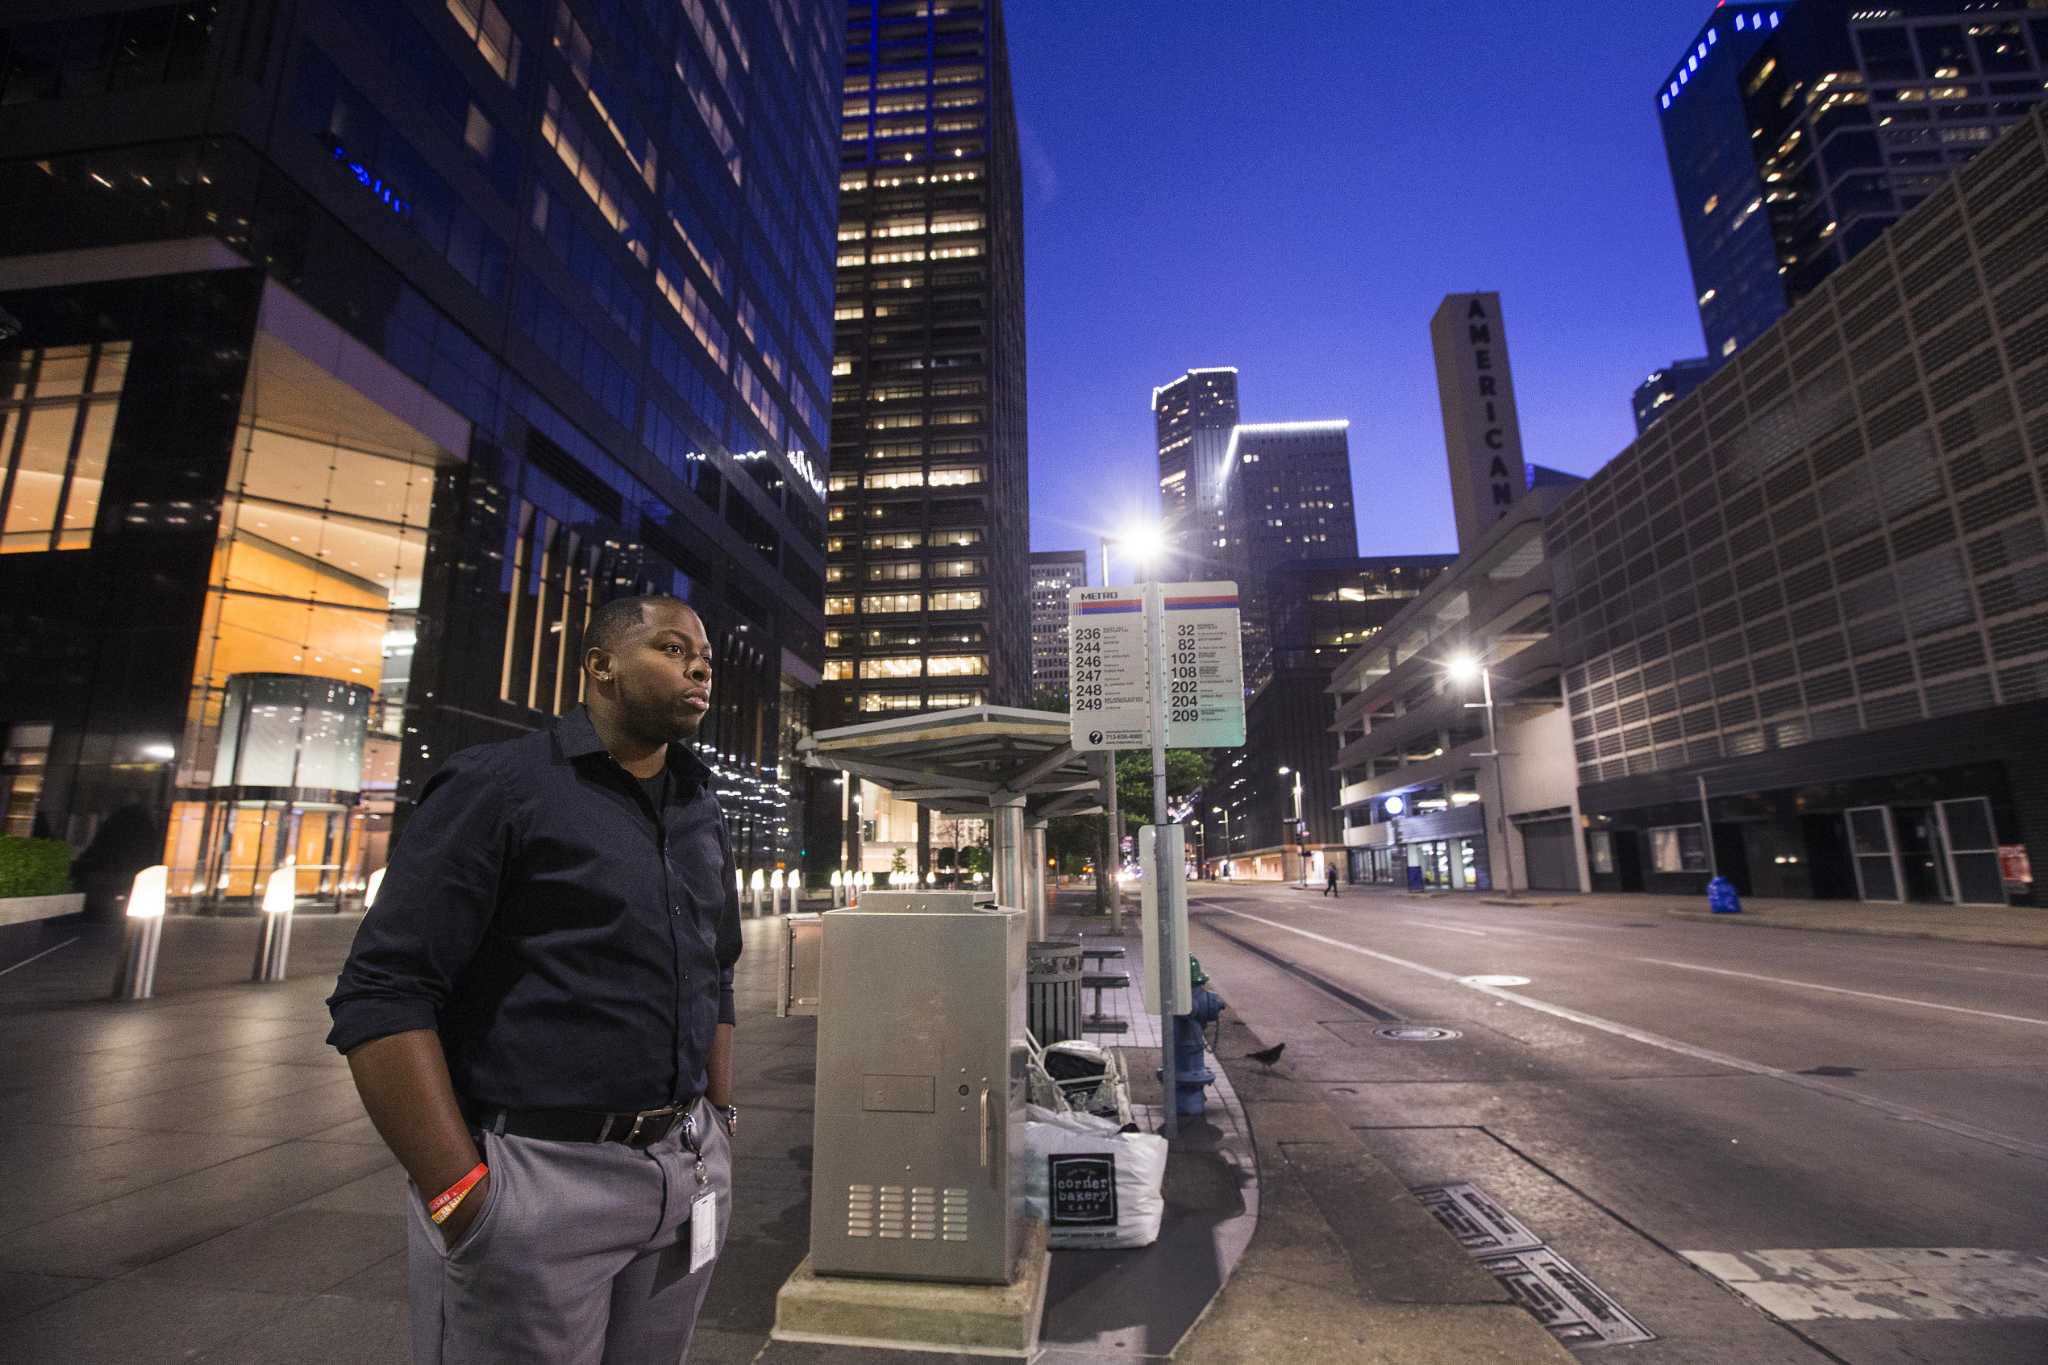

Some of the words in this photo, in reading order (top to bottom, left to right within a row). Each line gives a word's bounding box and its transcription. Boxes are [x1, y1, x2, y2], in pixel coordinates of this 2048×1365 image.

[1080, 591, 1118, 600] METRO
[1075, 628, 1101, 641] 236
[1178, 625, 1195, 636] 32
[1075, 642, 1101, 655] 244
[1178, 639, 1196, 651] 82
[1075, 656, 1102, 669] 246
[1171, 653, 1197, 665] 102
[1076, 670, 1102, 683] 247
[1171, 667, 1197, 679] 108
[1076, 684, 1103, 697] 248
[1171, 681, 1198, 693] 202
[1076, 698, 1103, 711] 249
[1172, 695, 1199, 708] 204
[1172, 710, 1199, 722] 209
[1057, 1175, 1108, 1190] corner
[1059, 1189, 1109, 1203] bakery
